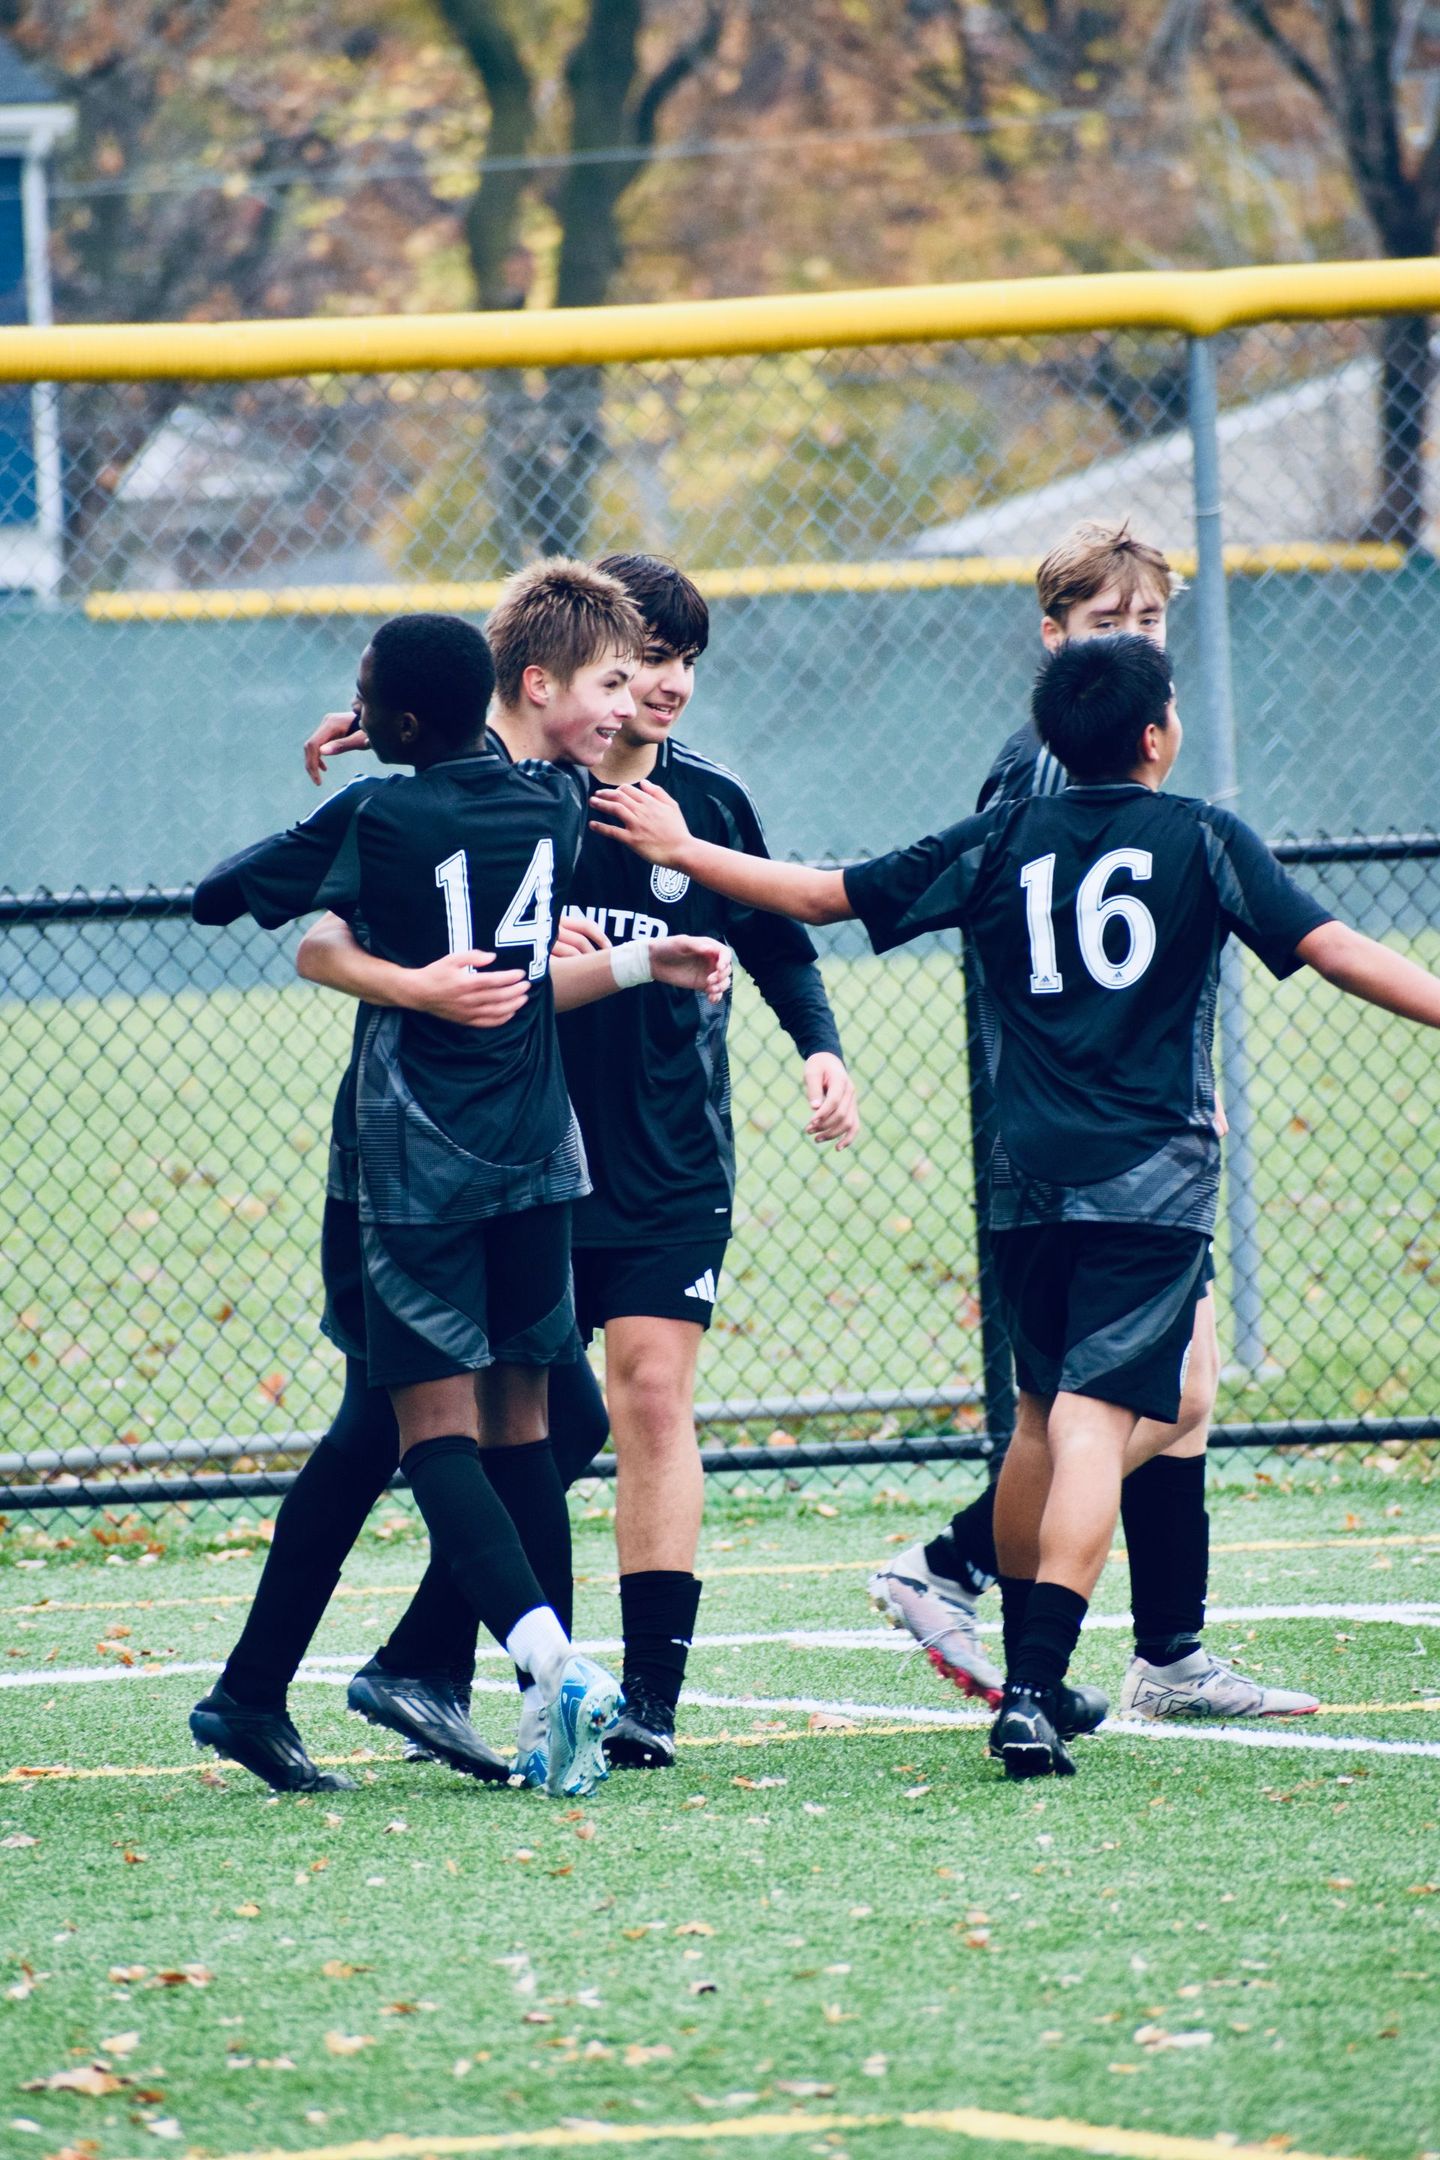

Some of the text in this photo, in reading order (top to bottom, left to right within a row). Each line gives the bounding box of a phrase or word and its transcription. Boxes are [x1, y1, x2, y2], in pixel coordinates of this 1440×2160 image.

[435, 838, 554, 980] 14
[562, 905, 669, 940] NITED
[1020, 847, 1157, 993] 16
